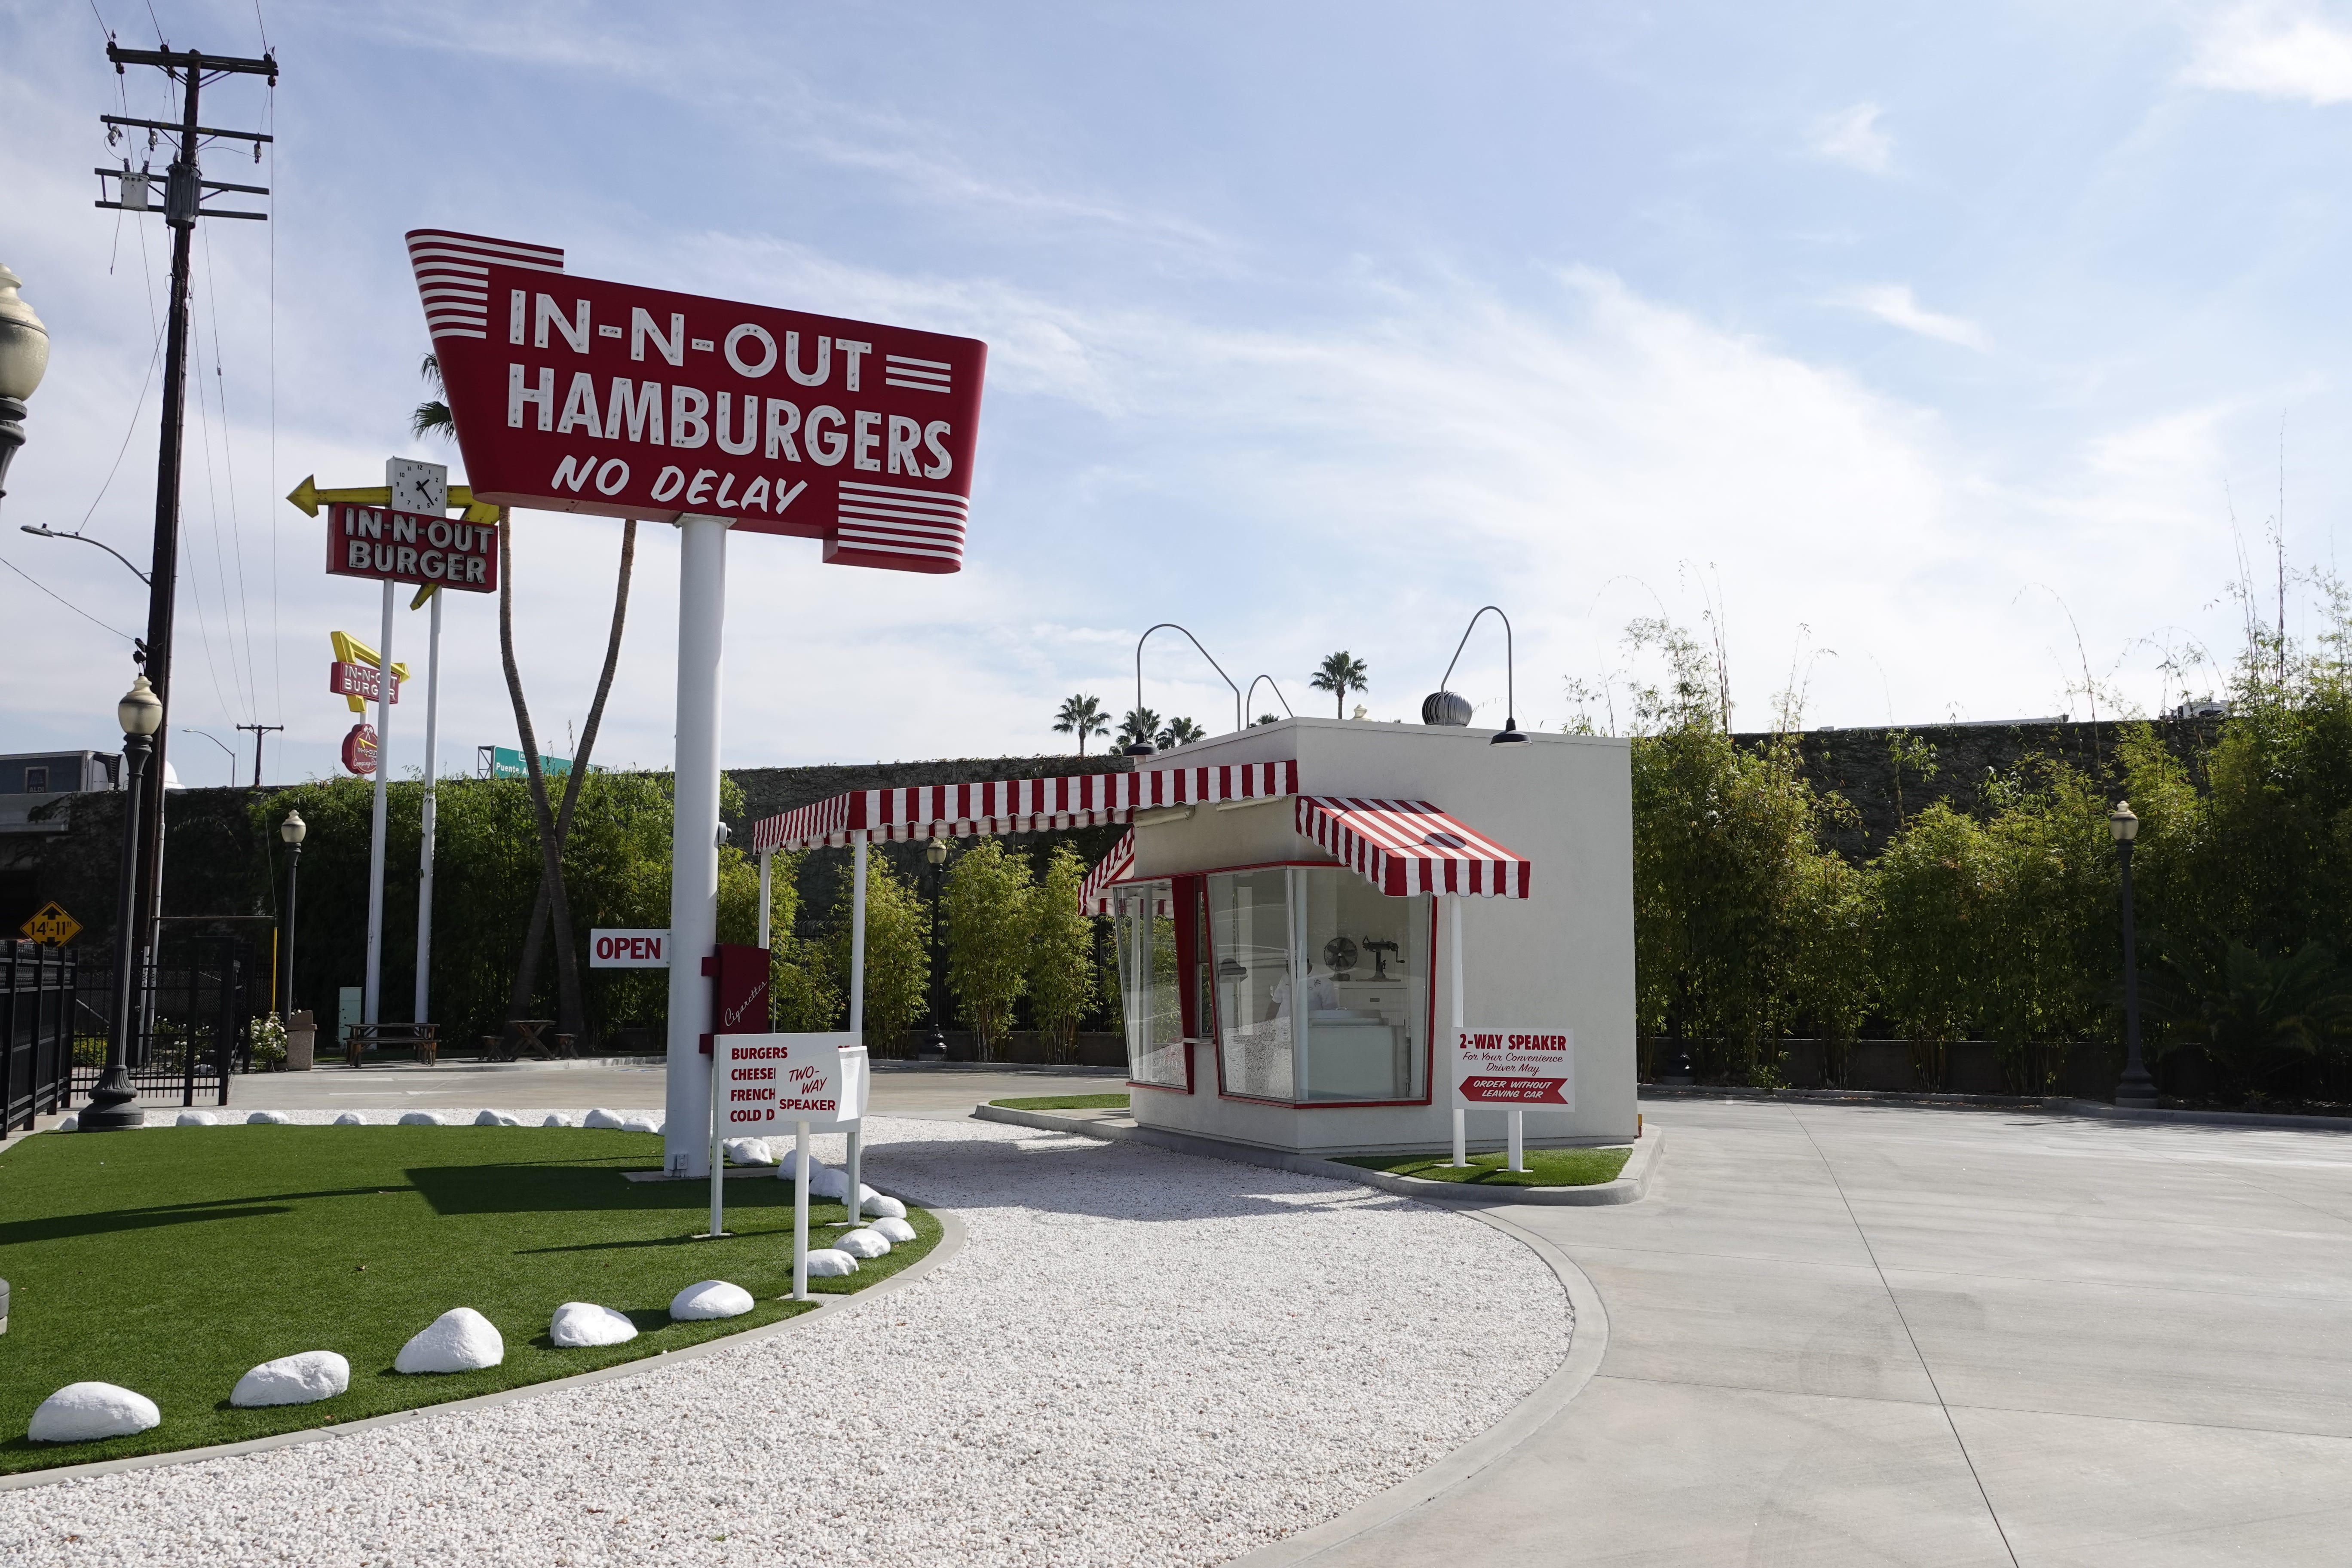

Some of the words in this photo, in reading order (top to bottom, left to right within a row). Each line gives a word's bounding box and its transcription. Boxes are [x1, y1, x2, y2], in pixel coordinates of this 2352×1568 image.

[510, 289, 871, 392] IN-N-OUT
[508, 363, 952, 480] HAMBURGERS
[551, 455, 630, 495] NO
[650, 465, 808, 514] DELAY
[346, 507, 494, 554] IN-N-OUT
[349, 539, 487, 584] BURGER
[344, 665, 398, 687] IN-N-OT
[344, 678, 395, 700] BURGR
[496, 762, 519, 774] Puente
[596, 937, 661, 959] OPEN
[725, 980, 768, 1026] Cigarettes
[1460, 1034, 1503, 1049] 2-WAY
[1508, 1035, 1566, 1050] SPEAKER
[732, 1047, 788, 1060] BURGERS
[1463, 1052, 1478, 1060] For
[1482, 1052, 1503, 1061] Your
[1506, 1052, 1563, 1063] Convenience
[731, 1067, 776, 1081] CHEESE
[789, 1066, 820, 1082] TWO-
[1486, 1063, 1516, 1072] Driver
[1518, 1063, 1540, 1077] May
[802, 1077, 827, 1095] WAY
[1510, 1081, 1553, 1089] WITHOUT
[731, 1088, 775, 1102] FRENCH
[1482, 1090, 1519, 1098] LEAVING
[1523, 1090, 1544, 1099] CAR
[779, 1099, 836, 1111] SPEAKER
[730, 1109, 762, 1122] COLD
